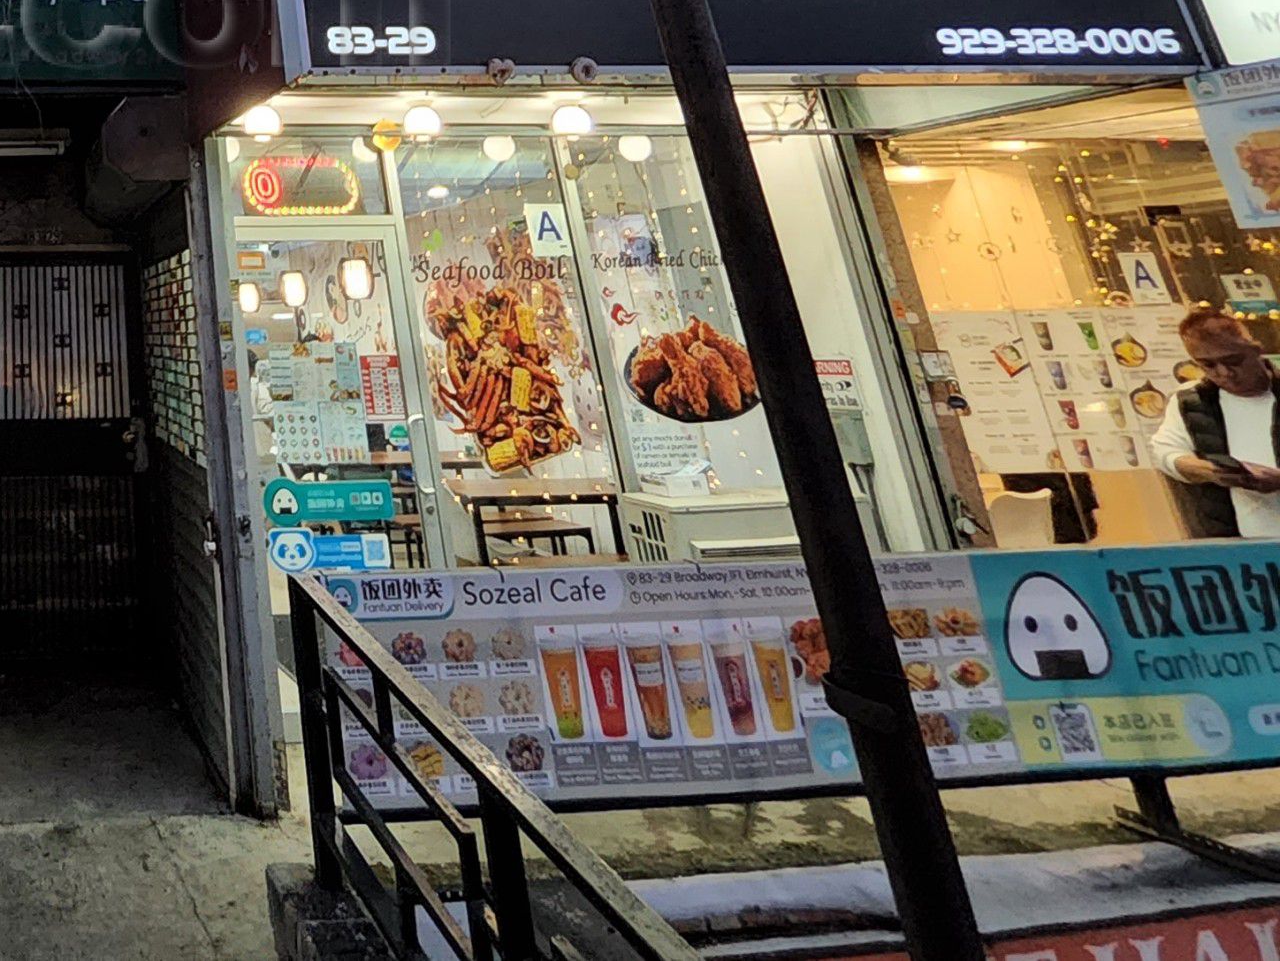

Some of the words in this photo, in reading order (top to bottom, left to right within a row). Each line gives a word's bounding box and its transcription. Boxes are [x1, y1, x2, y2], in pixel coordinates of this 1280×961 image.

[326, 26, 436, 55] 83-29
[936, 28, 1180, 55] 929-328-0006
[537, 210, 563, 241] A
[414, 256, 507, 285] Seafood
[513, 254, 568, 281] Boil
[591, 252, 642, 272] Korean
[689, 246, 719, 269] Chic
[1134, 258, 1161, 289] A
[815, 361, 851, 374] RNING
[360, 577, 443, 602] 饭团外卖
[464, 578, 543, 607] Sozeal
[551, 575, 607, 603] Cafe
[638, 572, 671, 584] 83-29
[363, 602, 402, 613] Fantuan
[405, 600, 445, 613] Delivery
[642, 592, 671, 605] Open
[1134, 647, 1260, 680] Fantuan
